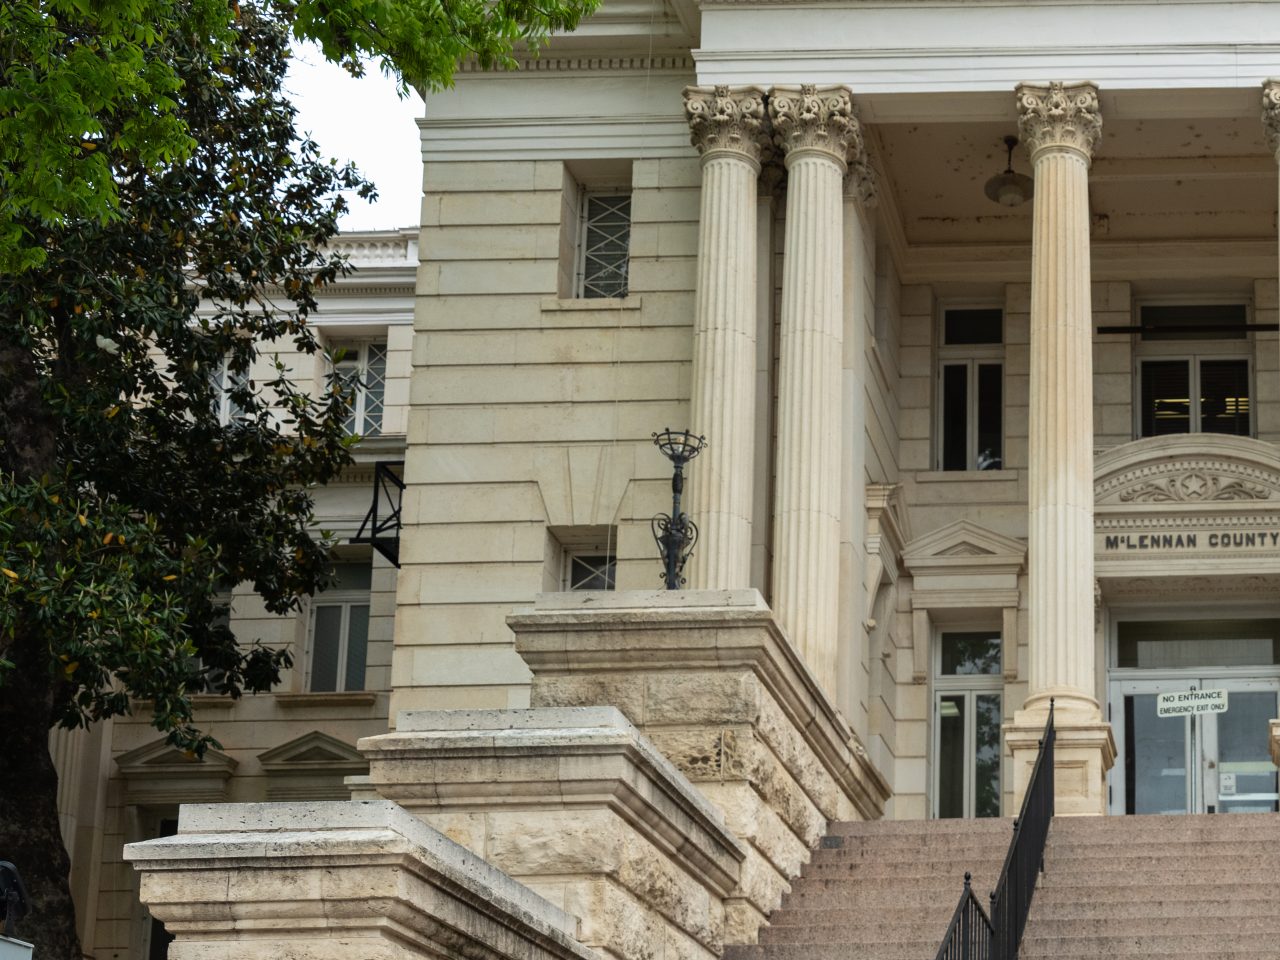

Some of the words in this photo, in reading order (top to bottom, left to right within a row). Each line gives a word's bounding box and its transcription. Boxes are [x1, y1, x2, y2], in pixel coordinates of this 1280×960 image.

[1162, 695, 1175, 703] NO
[1178, 691, 1222, 702] ENTRANCE
[1159, 705, 1194, 715] EMERGENCY
[1196, 703, 1209, 712] EXIT
[1211, 703, 1225, 711] ONLY
